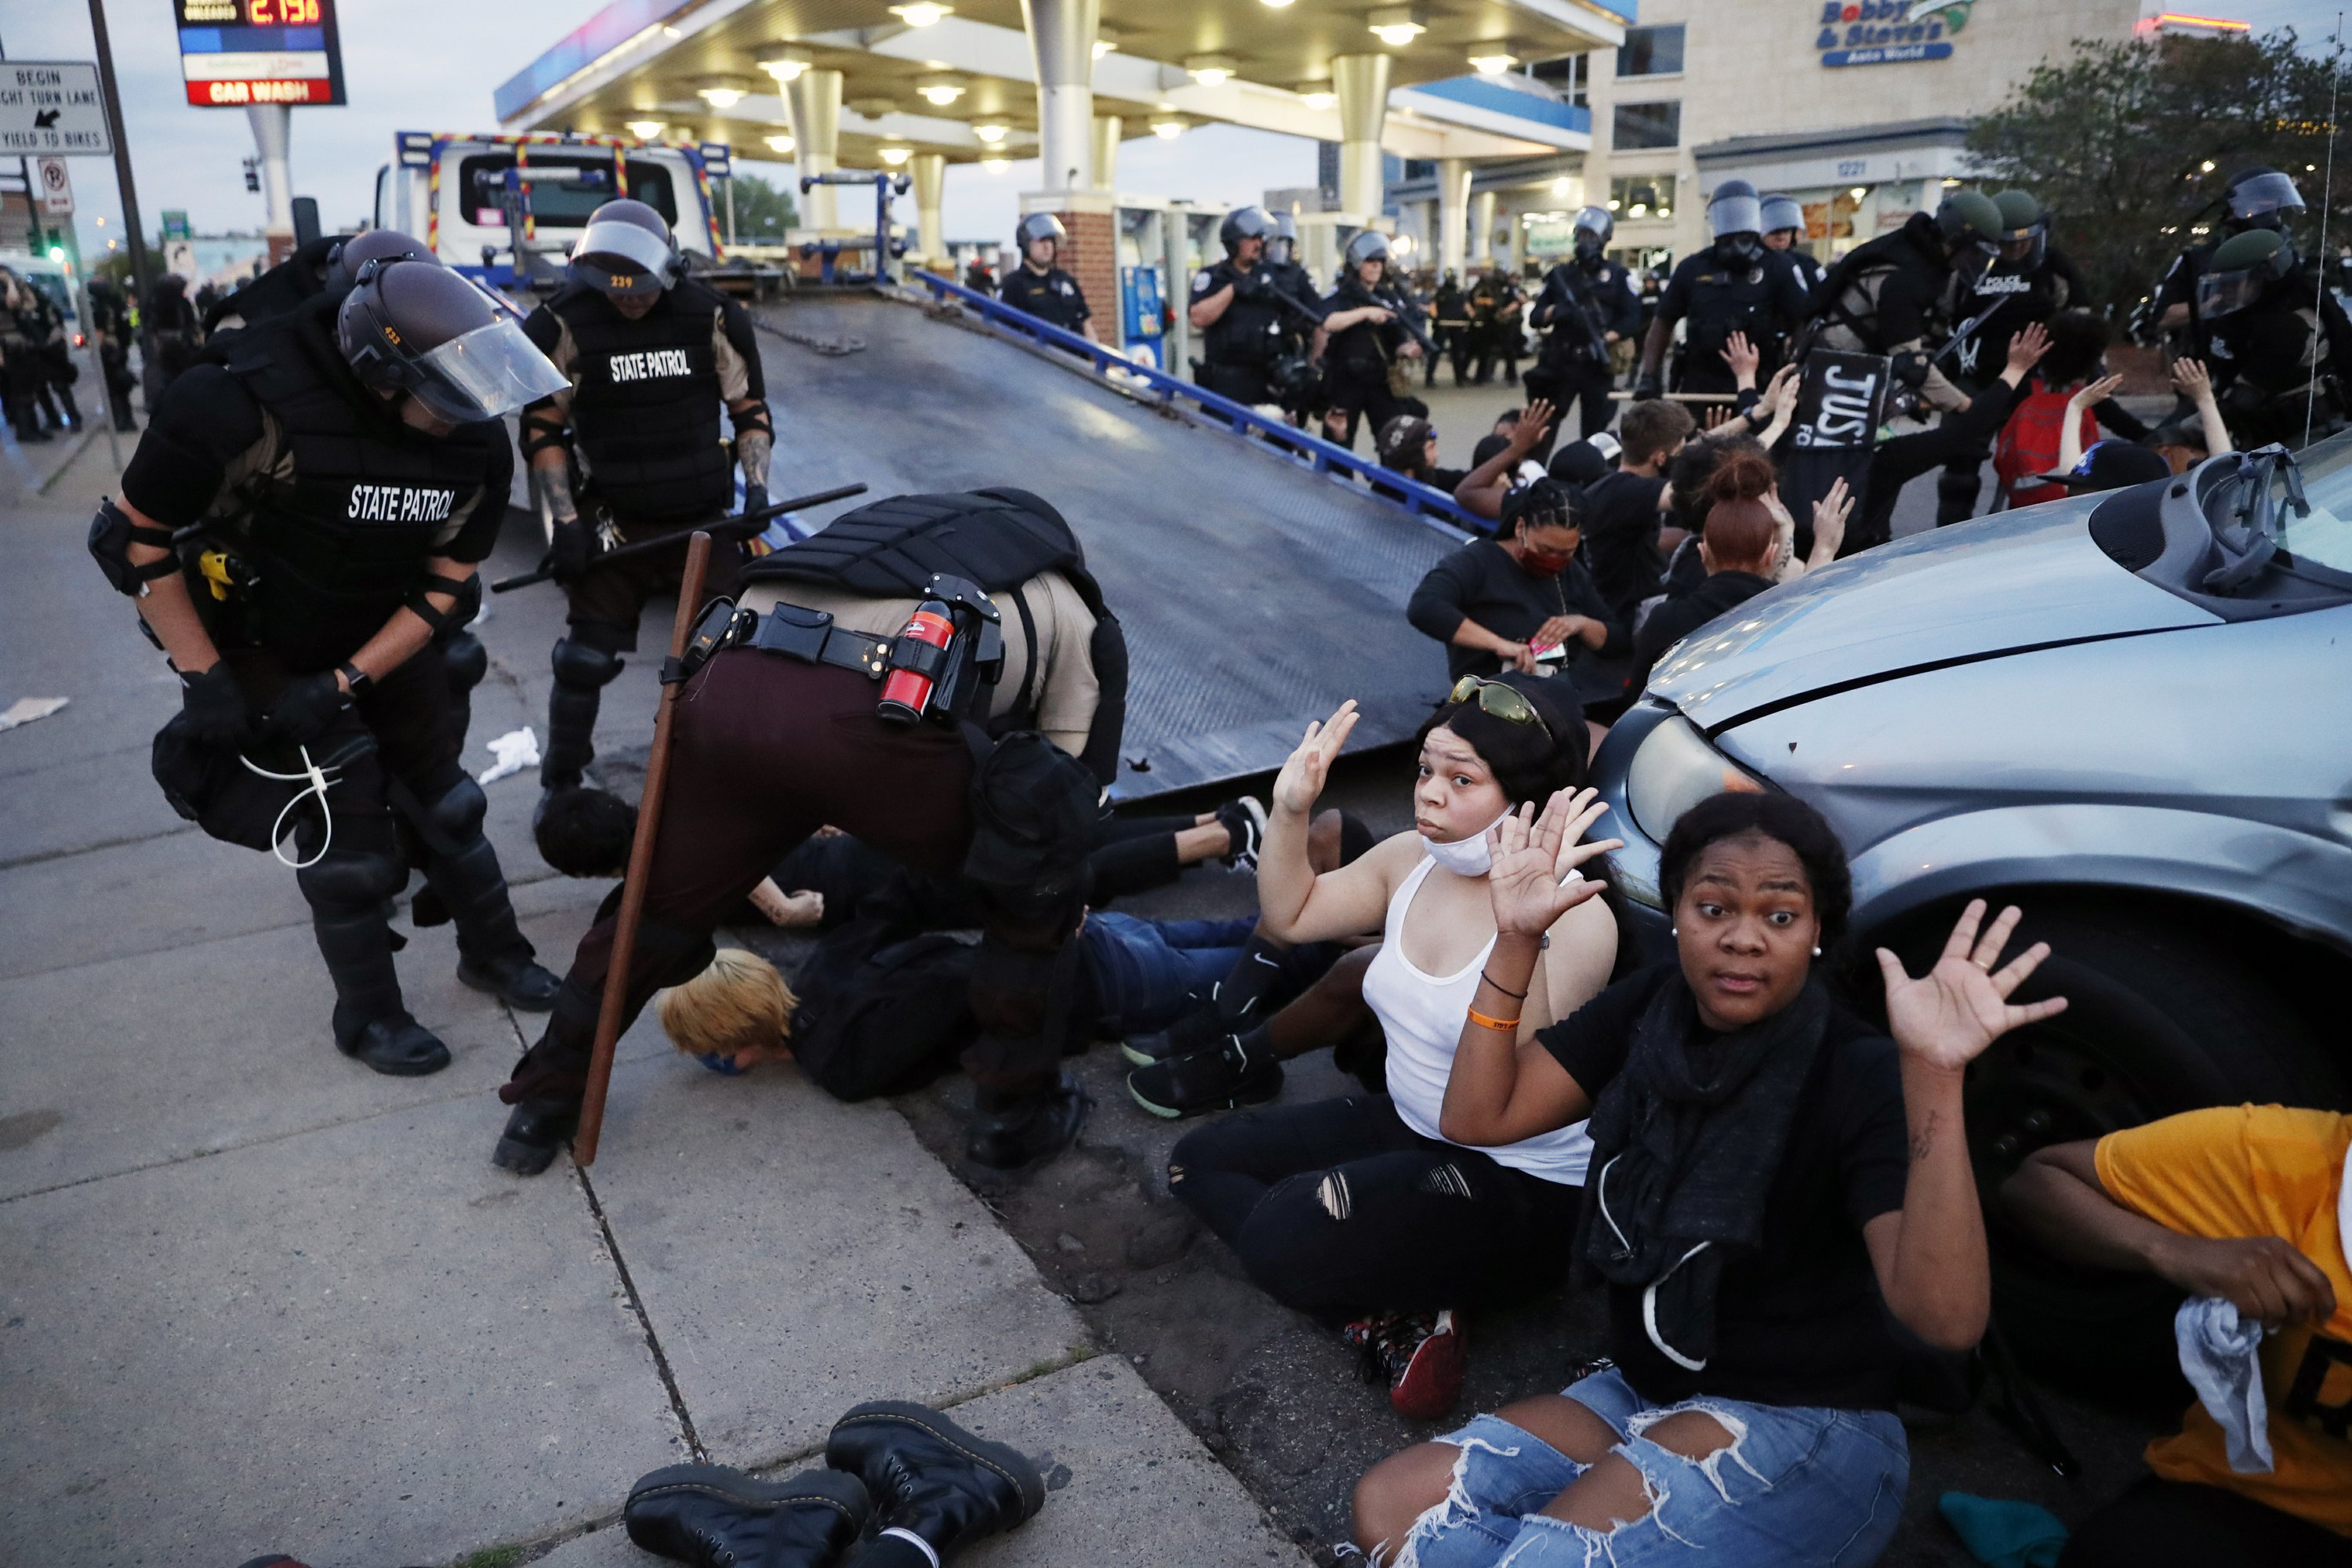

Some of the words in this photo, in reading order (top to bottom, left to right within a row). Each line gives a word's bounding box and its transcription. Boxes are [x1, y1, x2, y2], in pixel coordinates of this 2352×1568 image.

[1821, 0, 1911, 23] Bobby
[16, 70, 60, 85] BEGIN
[0, 90, 23, 105] GHT
[30, 90, 61, 105] TURN
[66, 90, 96, 105] LANE
[209, 82, 249, 102] CAR
[251, 81, 309, 102] WASH
[3, 132, 38, 147] YIELD
[45, 132, 60, 147] TO
[64, 131, 100, 147] BIKES
[1986, 275, 2020, 285] POLICE
[610, 353, 648, 383] STATE
[646, 350, 691, 378] PATROL
[1795, 423, 1813, 446] FO
[348, 484, 401, 519] STATE
[400, 488, 456, 521] PATROL
